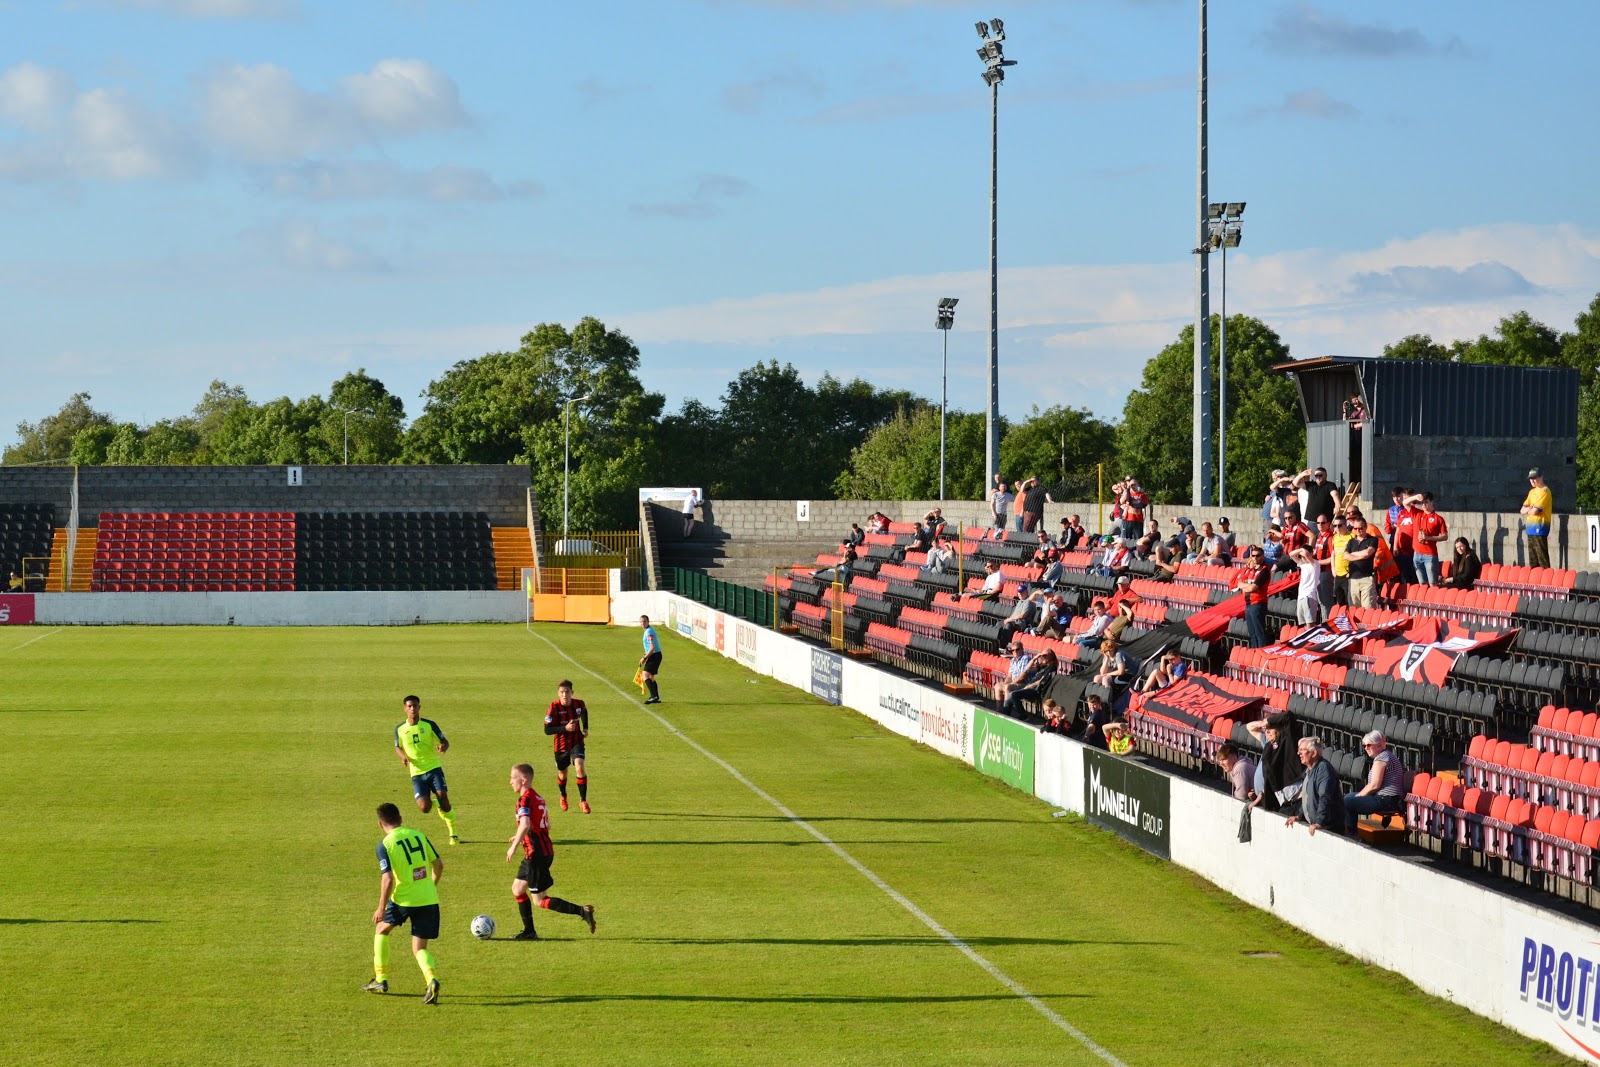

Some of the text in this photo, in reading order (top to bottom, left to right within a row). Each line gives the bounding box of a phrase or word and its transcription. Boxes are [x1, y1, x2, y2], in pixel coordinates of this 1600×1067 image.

[921, 705, 959, 745] providers.ie
[987, 732, 1001, 764] sse
[1090, 763, 1163, 837] MUNNELLY GROUP
[396, 835, 426, 866] 14
